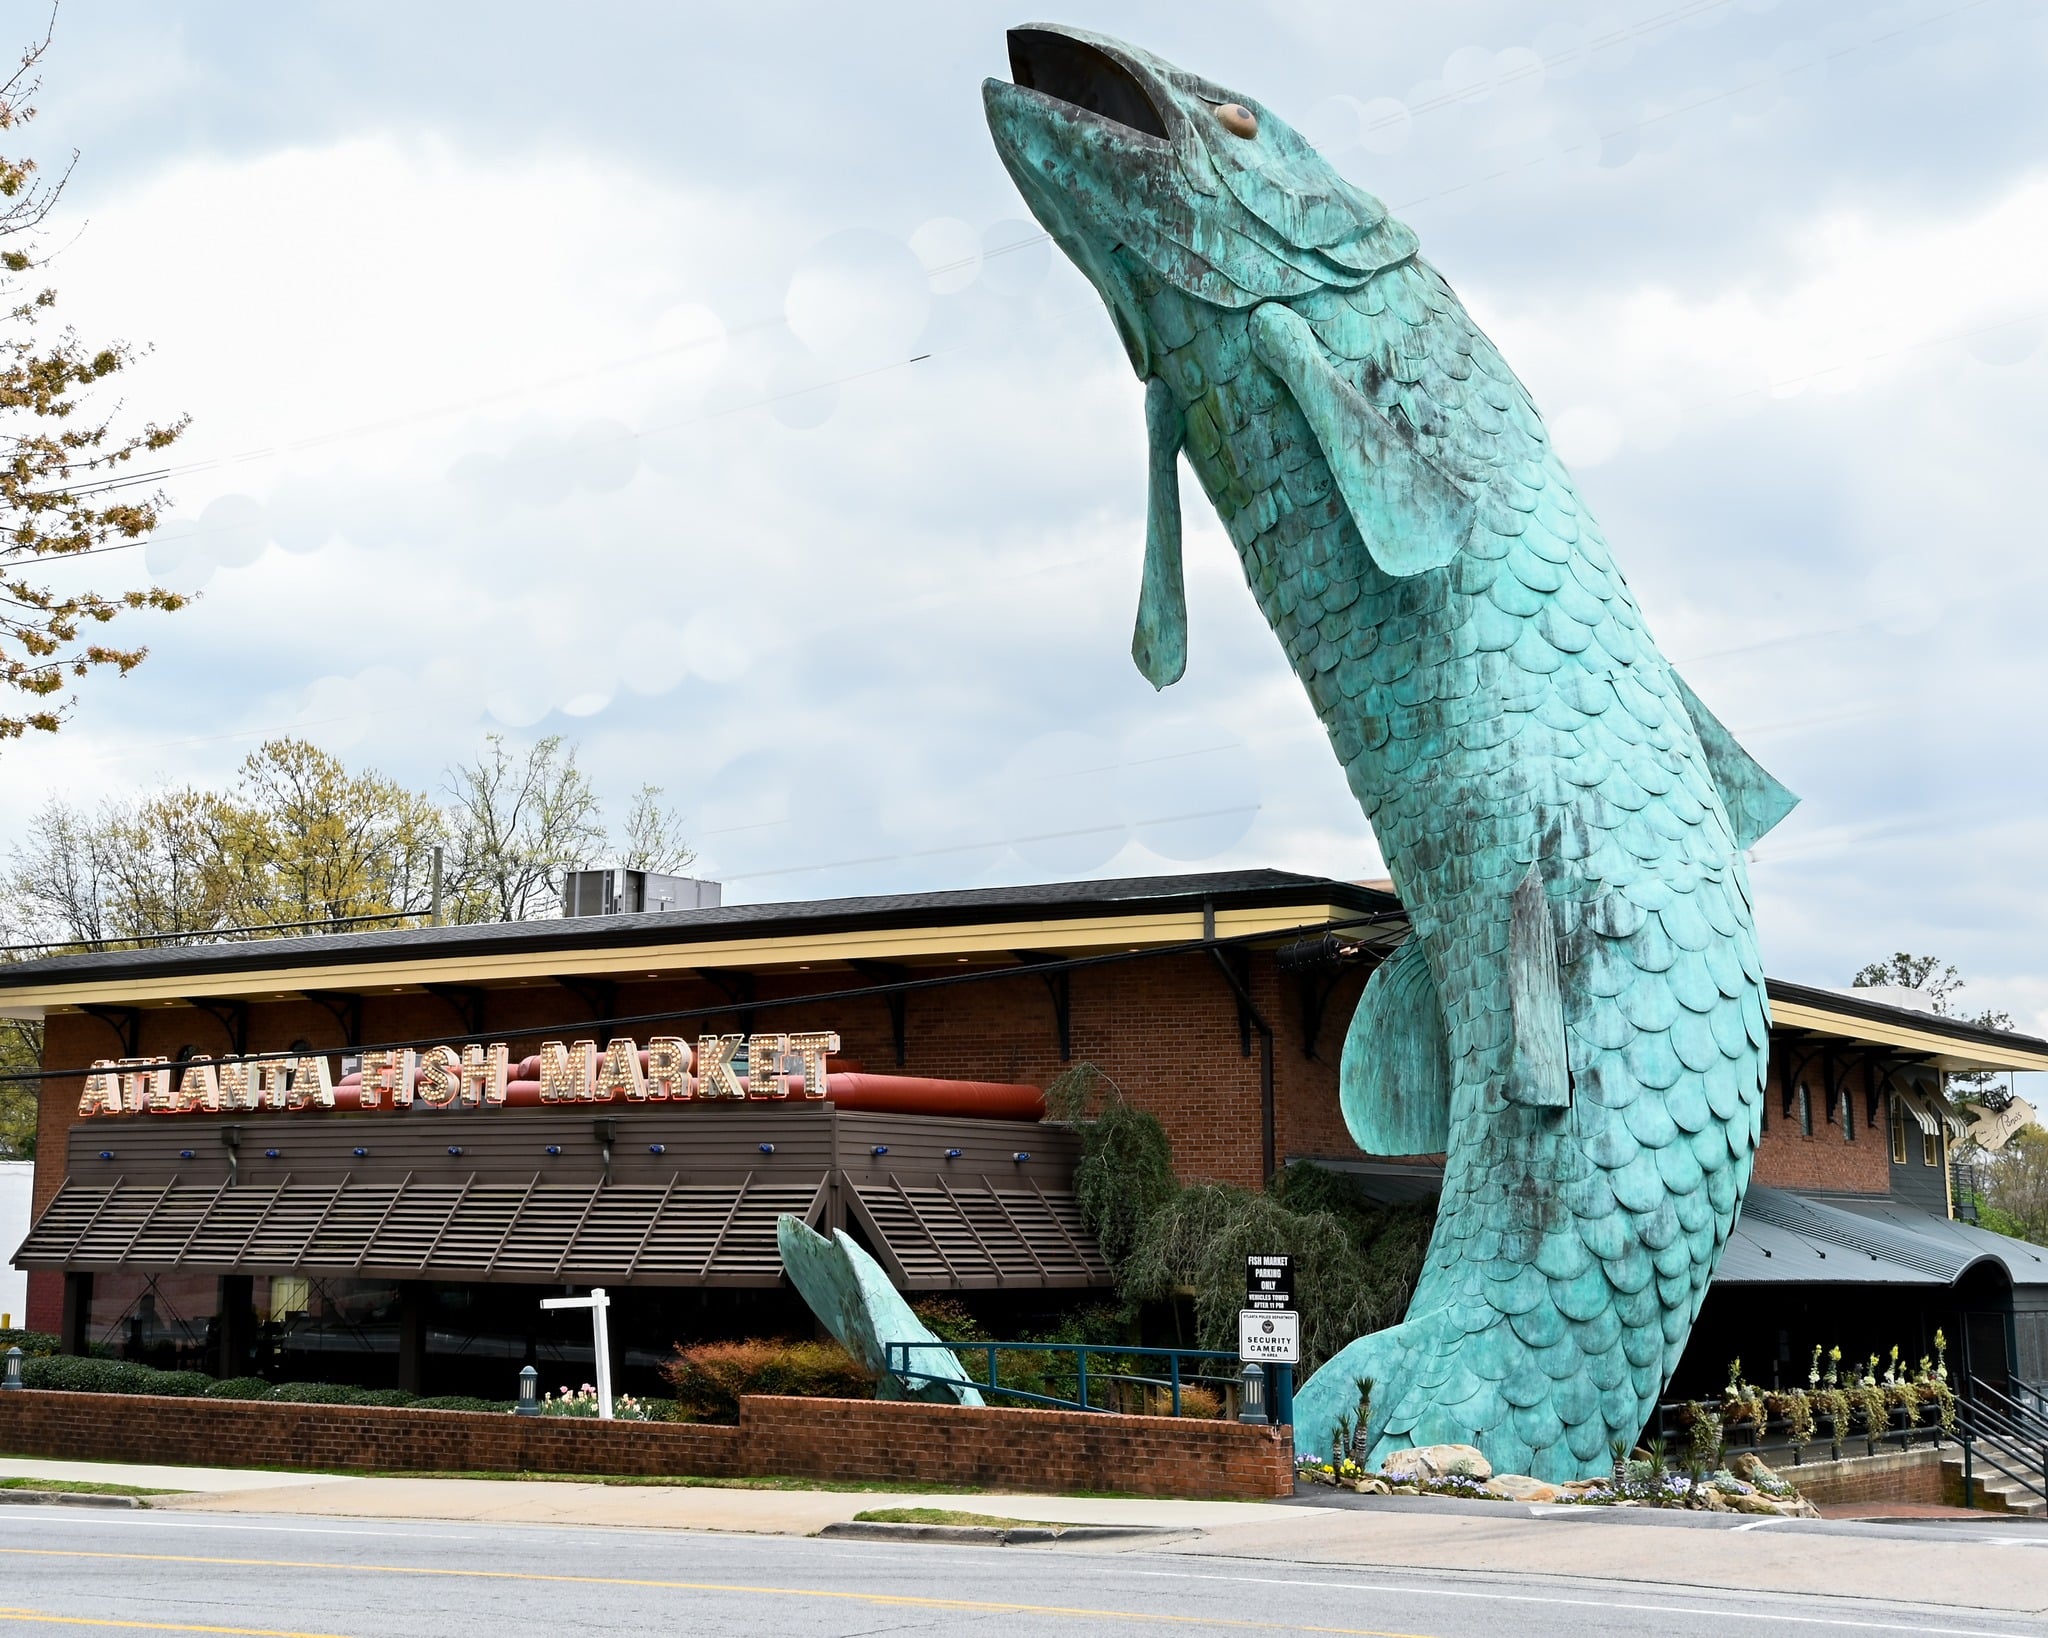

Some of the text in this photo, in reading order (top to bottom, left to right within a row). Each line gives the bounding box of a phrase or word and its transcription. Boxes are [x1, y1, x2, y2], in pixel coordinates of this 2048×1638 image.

[79, 1031, 839, 1116] ATLANTA FISH MARKET
[1248, 1256, 1288, 1265] FISH MARKET
[1255, 1269, 1281, 1278] PARKING
[1261, 1281, 1276, 1290] ONLY
[1272, 1294, 1289, 1302] TOWED
[1254, 1301, 1269, 1309] AFTER
[1247, 1336, 1291, 1344] SECURITY
[1250, 1345, 1289, 1353] CAMERA
